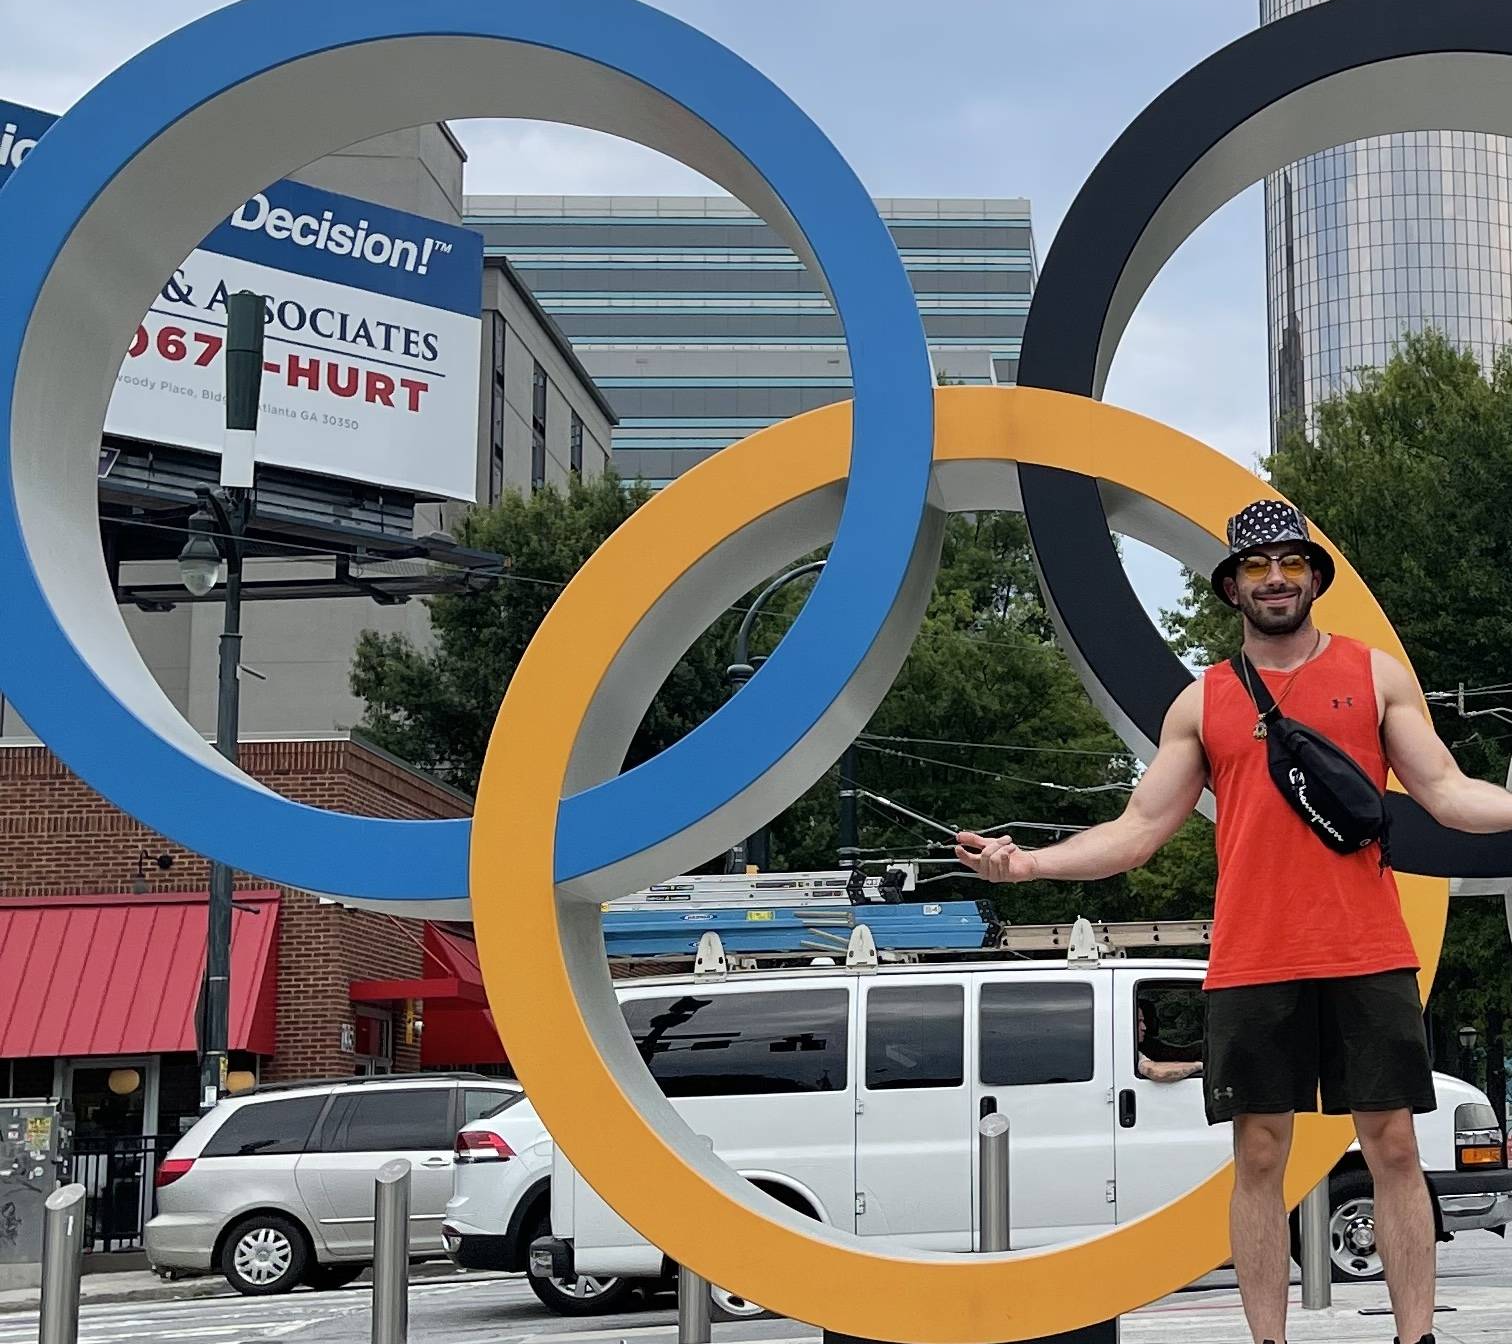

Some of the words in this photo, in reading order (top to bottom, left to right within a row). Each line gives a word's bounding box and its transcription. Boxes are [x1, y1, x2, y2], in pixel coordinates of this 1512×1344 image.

[161, 268, 197, 308] &
[203, 279, 438, 362] ASOCIATES
[259, 403, 297, 418] tlanta
[300, 410, 318, 423] GA
[322, 414, 359, 430] 30350
[1289, 767, 1344, 842] Champion
